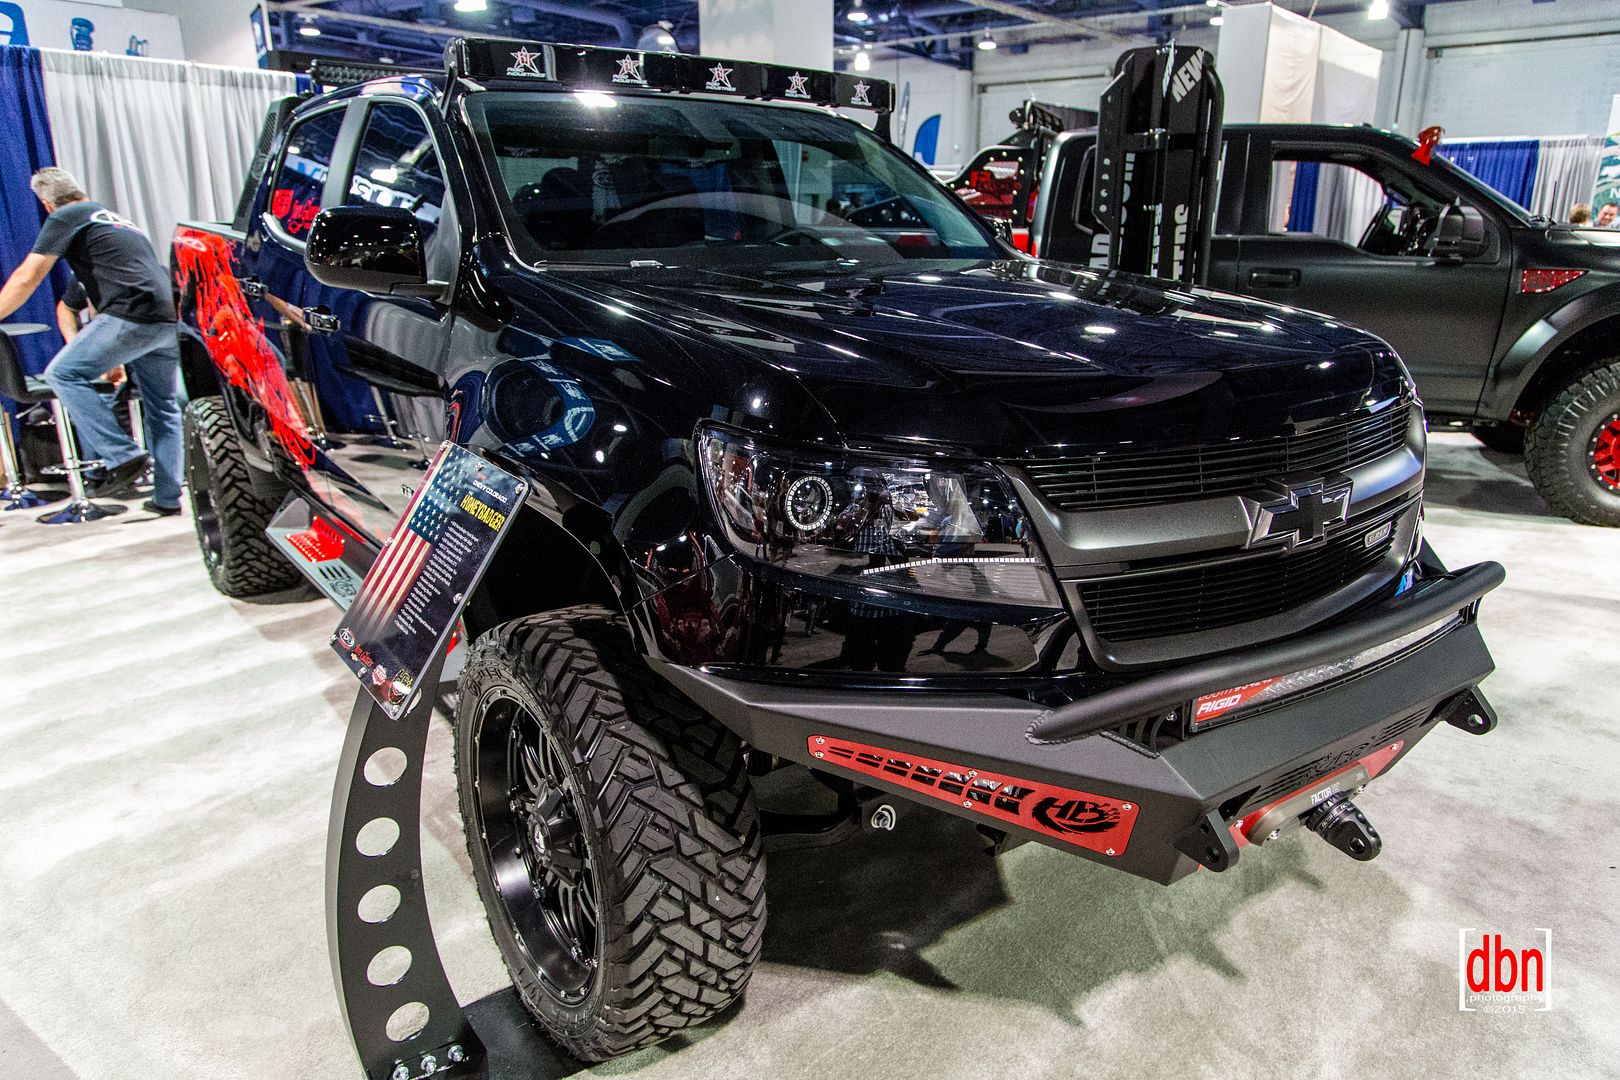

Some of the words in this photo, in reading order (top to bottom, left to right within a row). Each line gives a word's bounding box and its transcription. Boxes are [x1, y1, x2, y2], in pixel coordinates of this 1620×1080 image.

[485, 487, 508, 504] COLORADO
[459, 494, 506, 532] HONEYBADGER
[1196, 694, 1242, 715] RIGID
[1311, 786, 1332, 806] FACTOR
